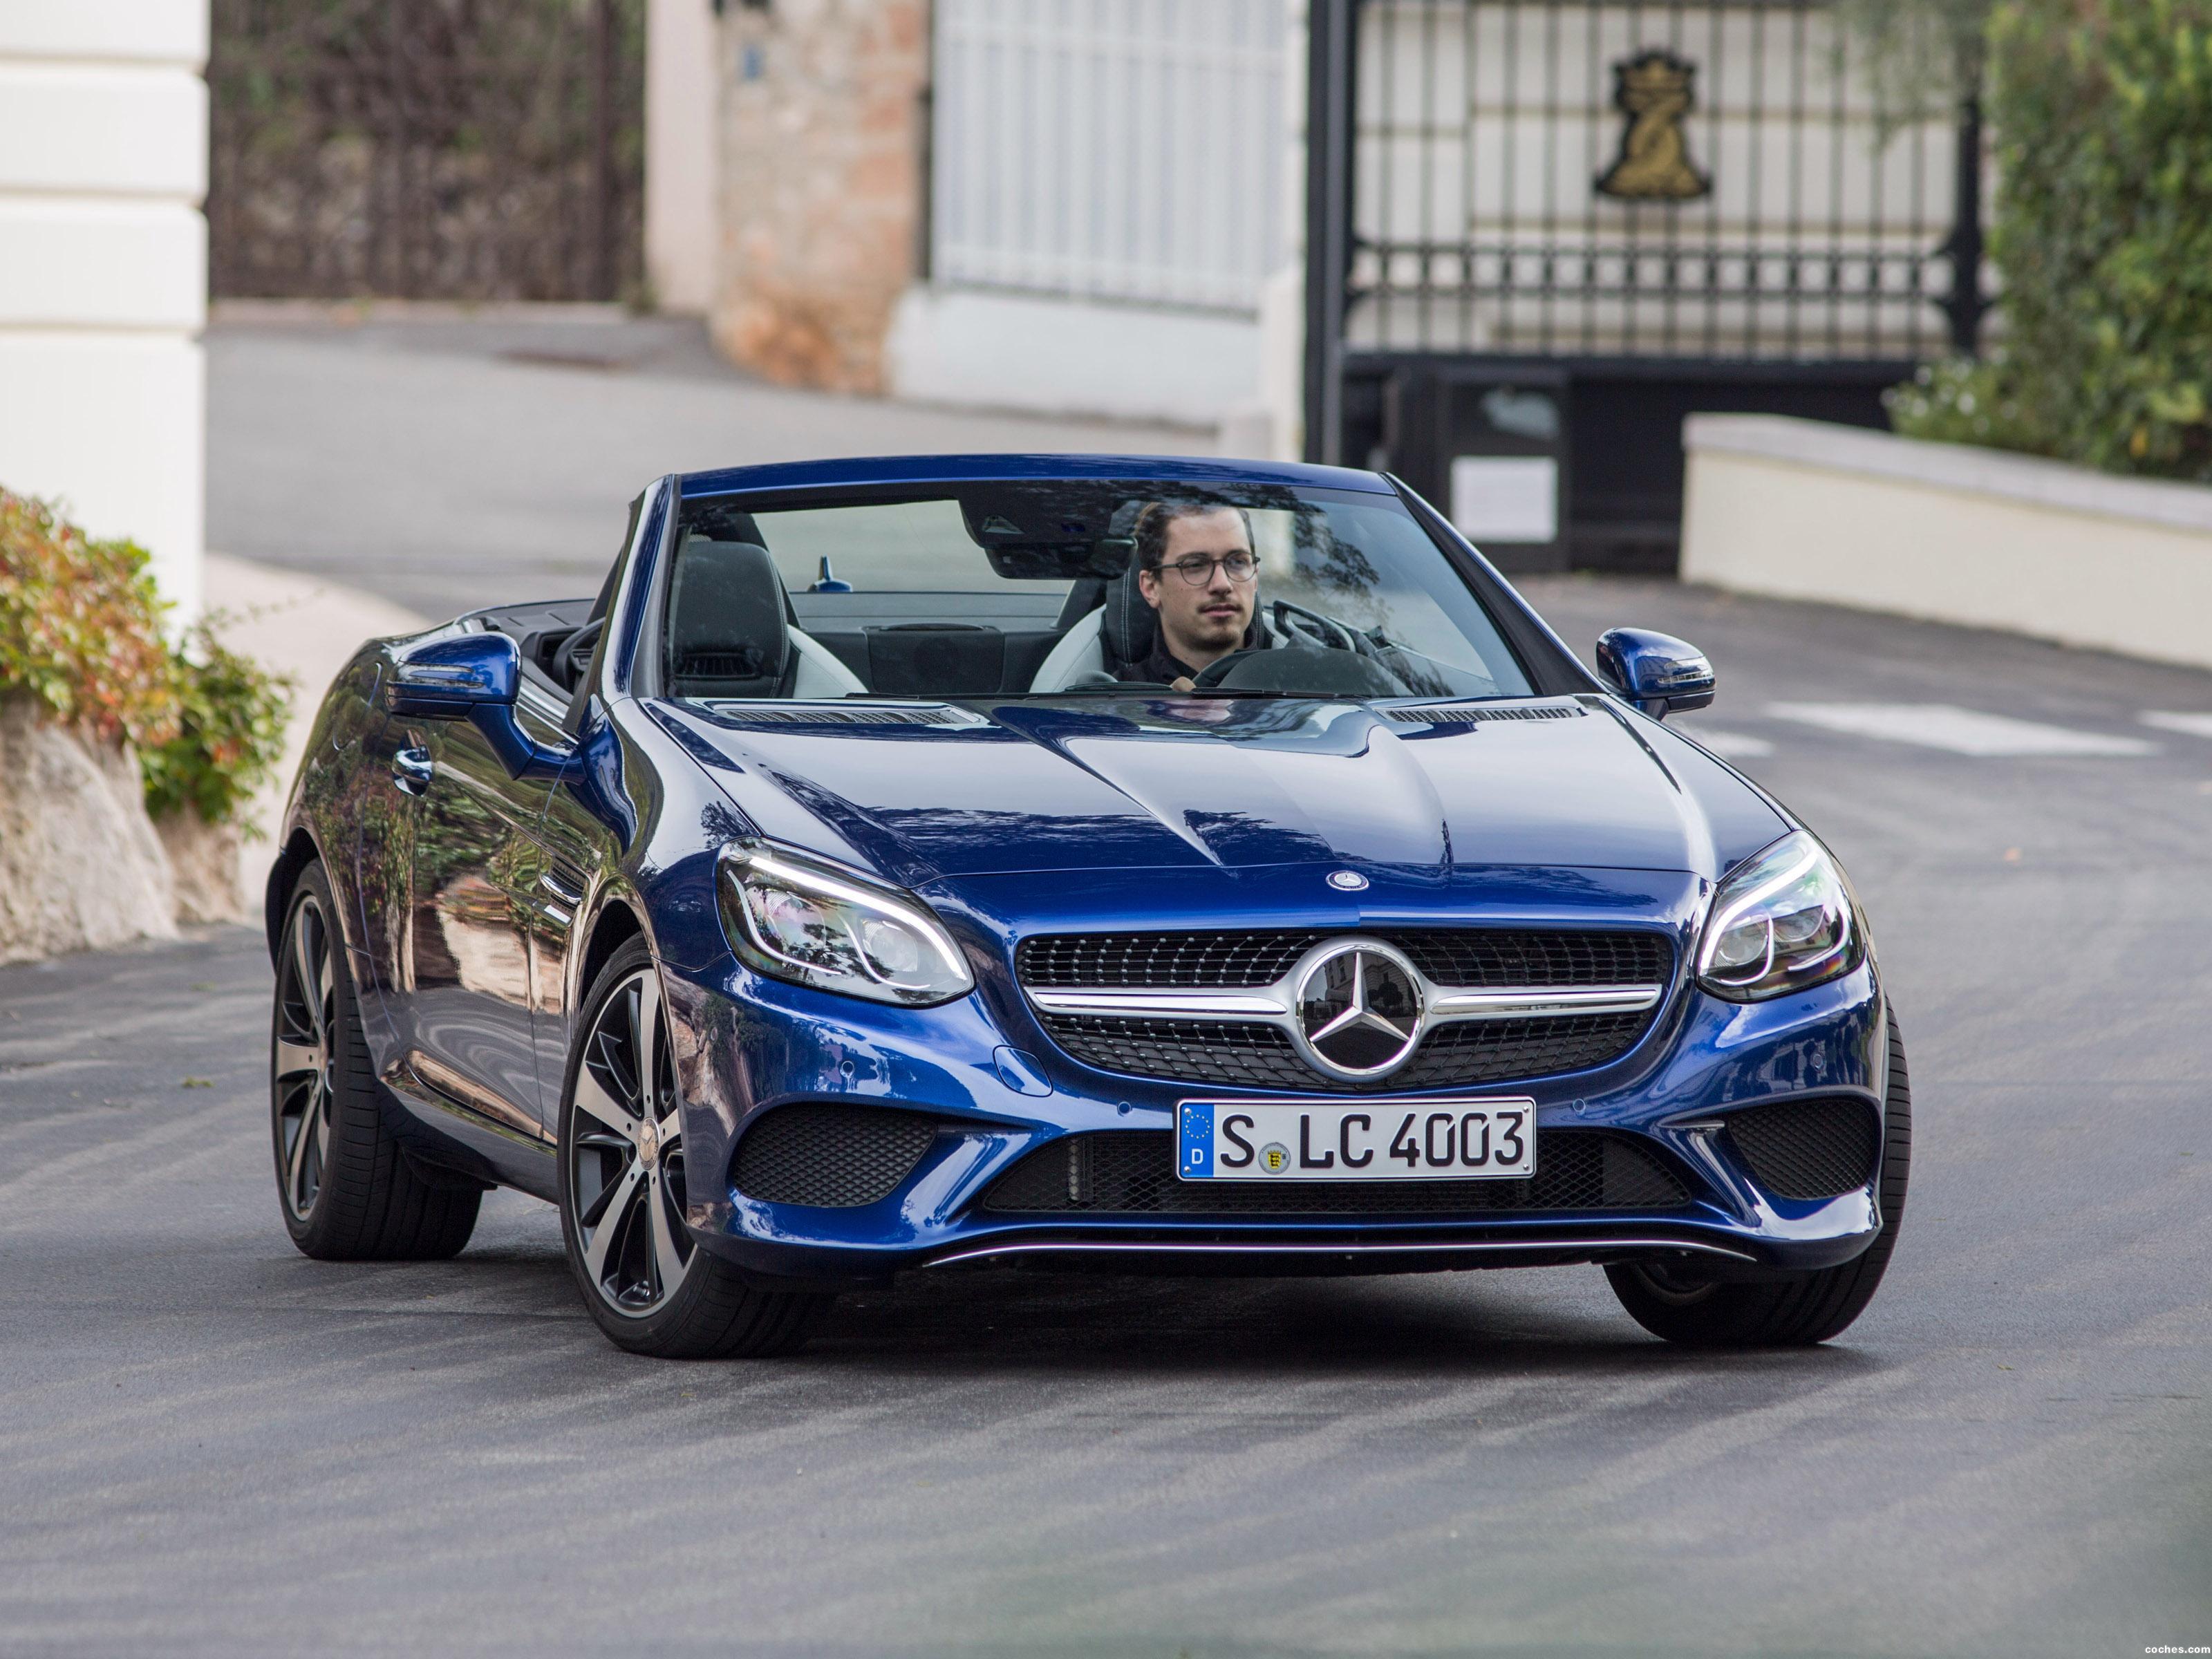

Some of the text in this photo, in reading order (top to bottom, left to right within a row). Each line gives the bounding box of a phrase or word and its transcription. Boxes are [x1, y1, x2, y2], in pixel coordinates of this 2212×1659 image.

[1191, 1148, 1203, 1165] D
[1220, 1114, 1255, 1168] S
[1300, 1114, 1374, 1168] LC
[1389, 1112, 1524, 1168] 4003
